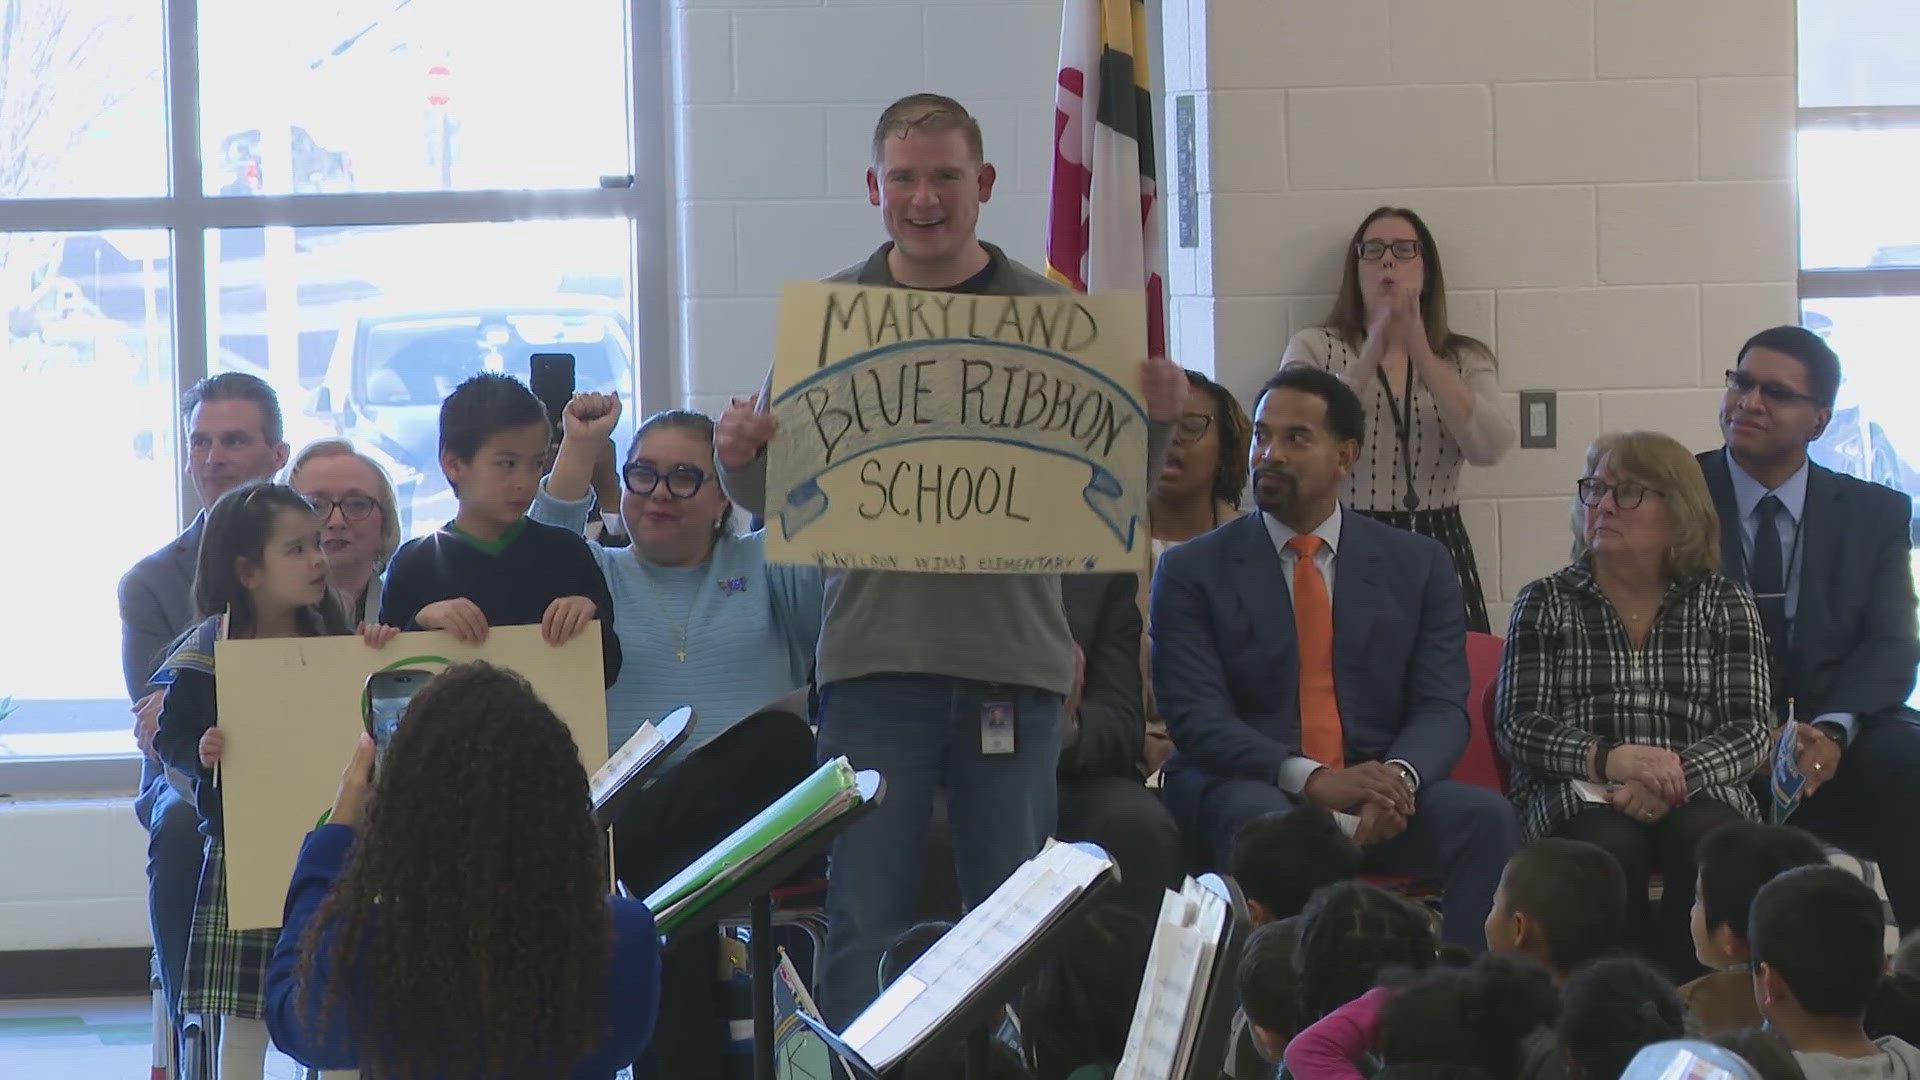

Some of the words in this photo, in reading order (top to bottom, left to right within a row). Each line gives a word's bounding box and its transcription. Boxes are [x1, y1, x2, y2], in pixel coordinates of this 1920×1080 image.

[818, 290, 1098, 368] MARYLAND
[798, 359, 938, 463] BLUE
[960, 358, 1132, 457] RIBBON
[858, 458, 1031, 524] SCHOOL
[978, 555, 1075, 571] ELEMENTARY
